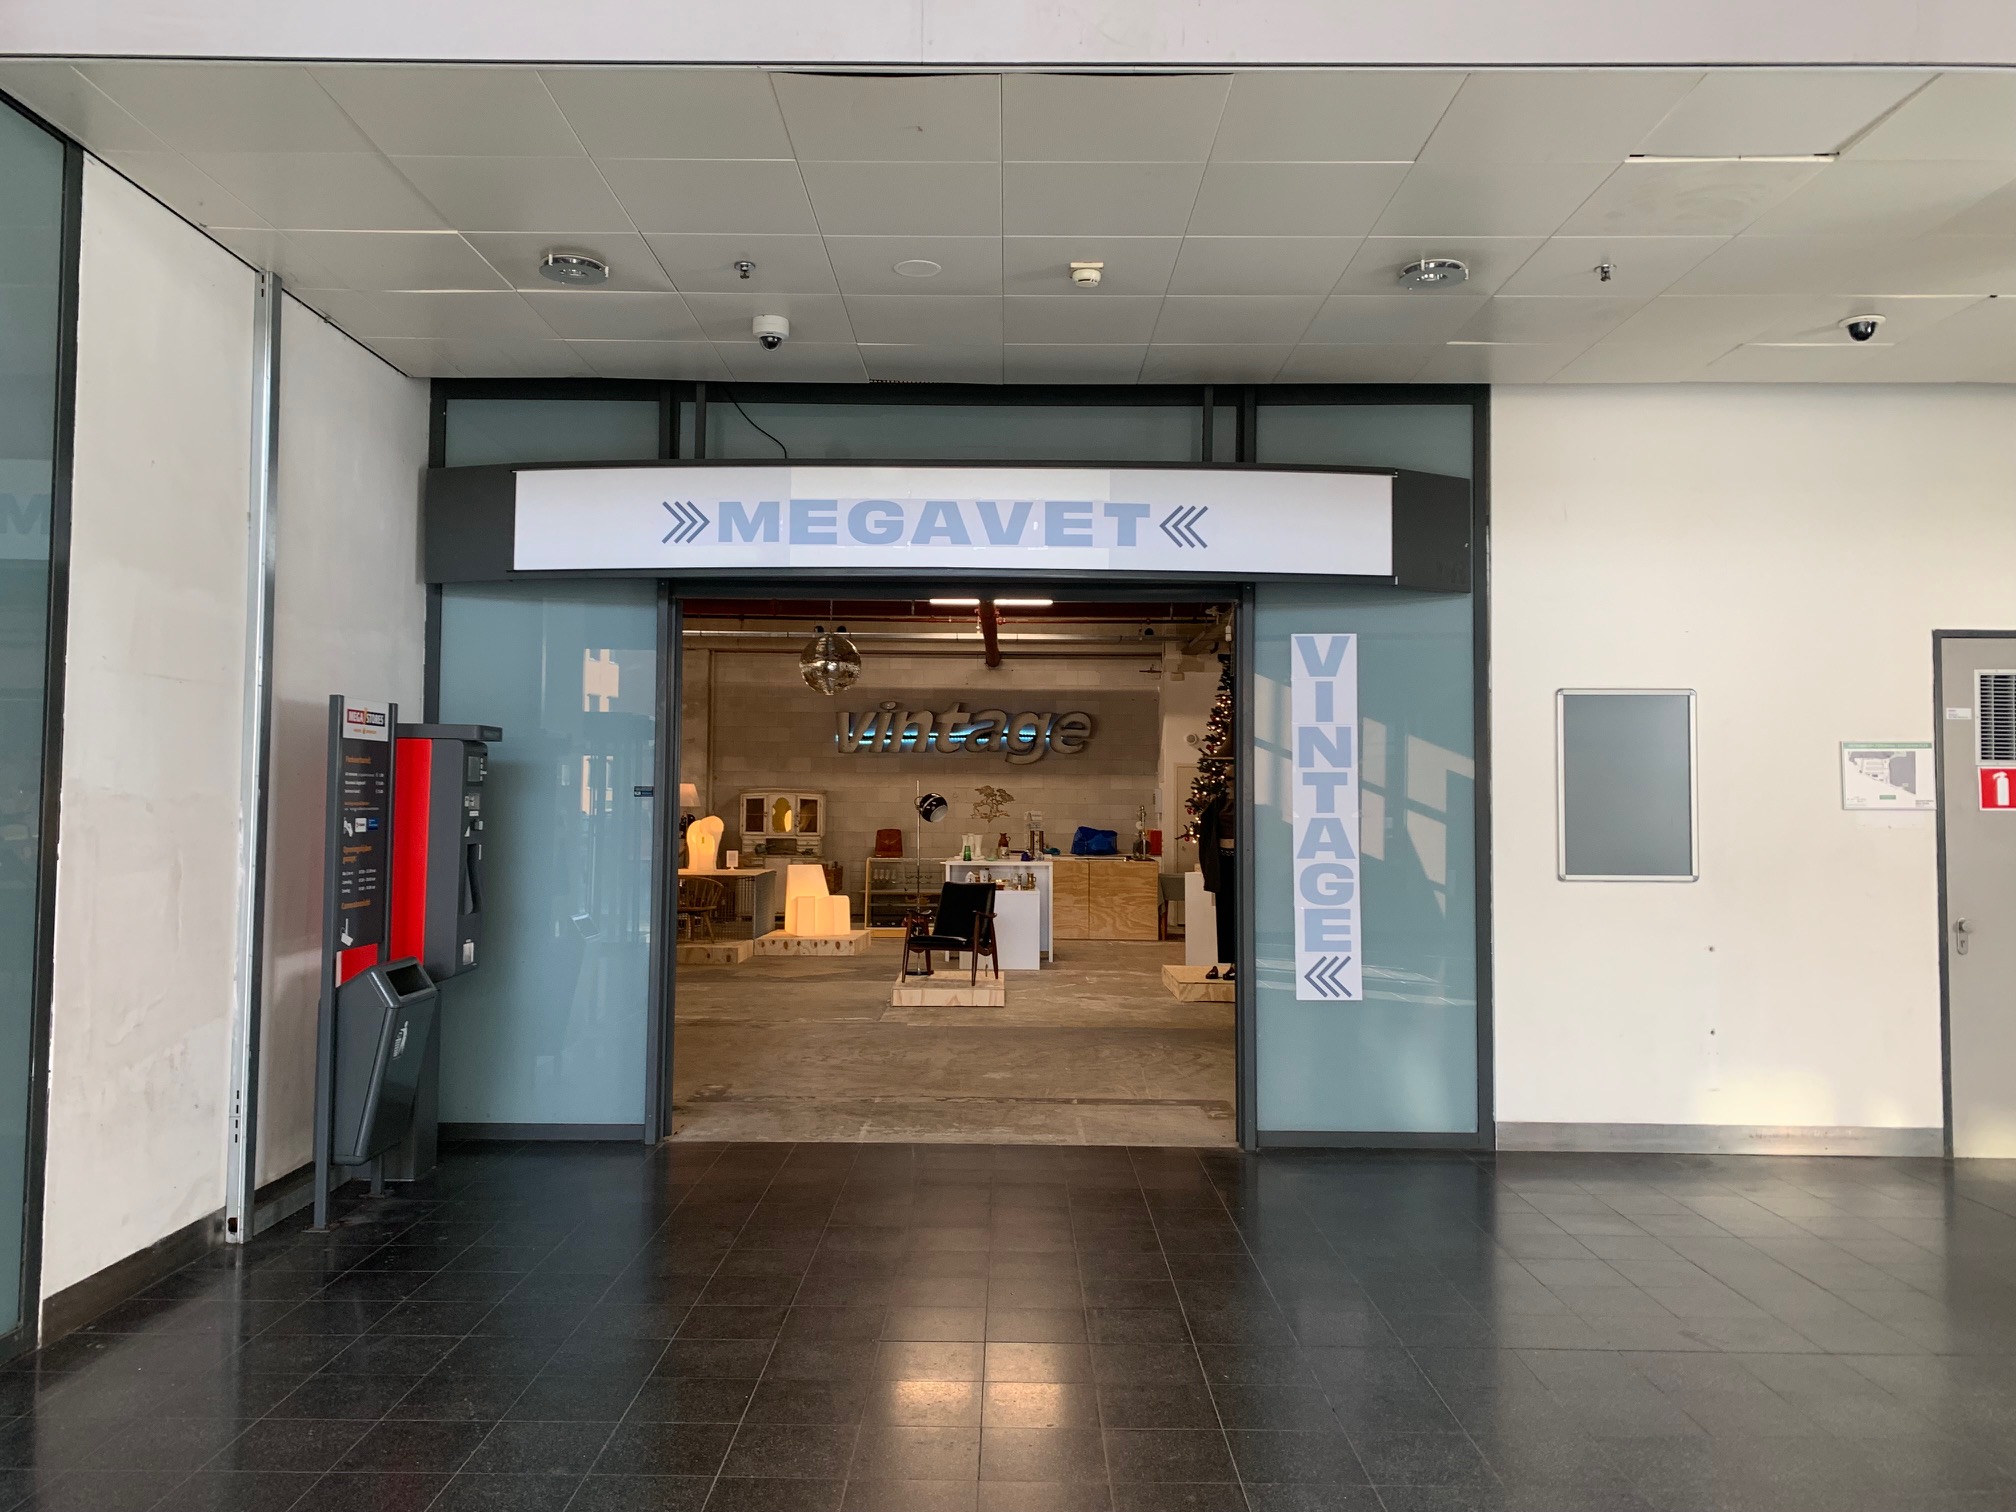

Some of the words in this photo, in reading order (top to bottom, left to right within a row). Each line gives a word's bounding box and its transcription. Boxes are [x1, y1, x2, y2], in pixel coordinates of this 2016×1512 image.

[717, 499, 1151, 547] MEGAVET
[348, 710, 364, 723] MEGA
[366, 712, 385, 726] STORES
[836, 701, 1093, 765] vintage
[1295, 635, 1357, 953] VINTAGE
